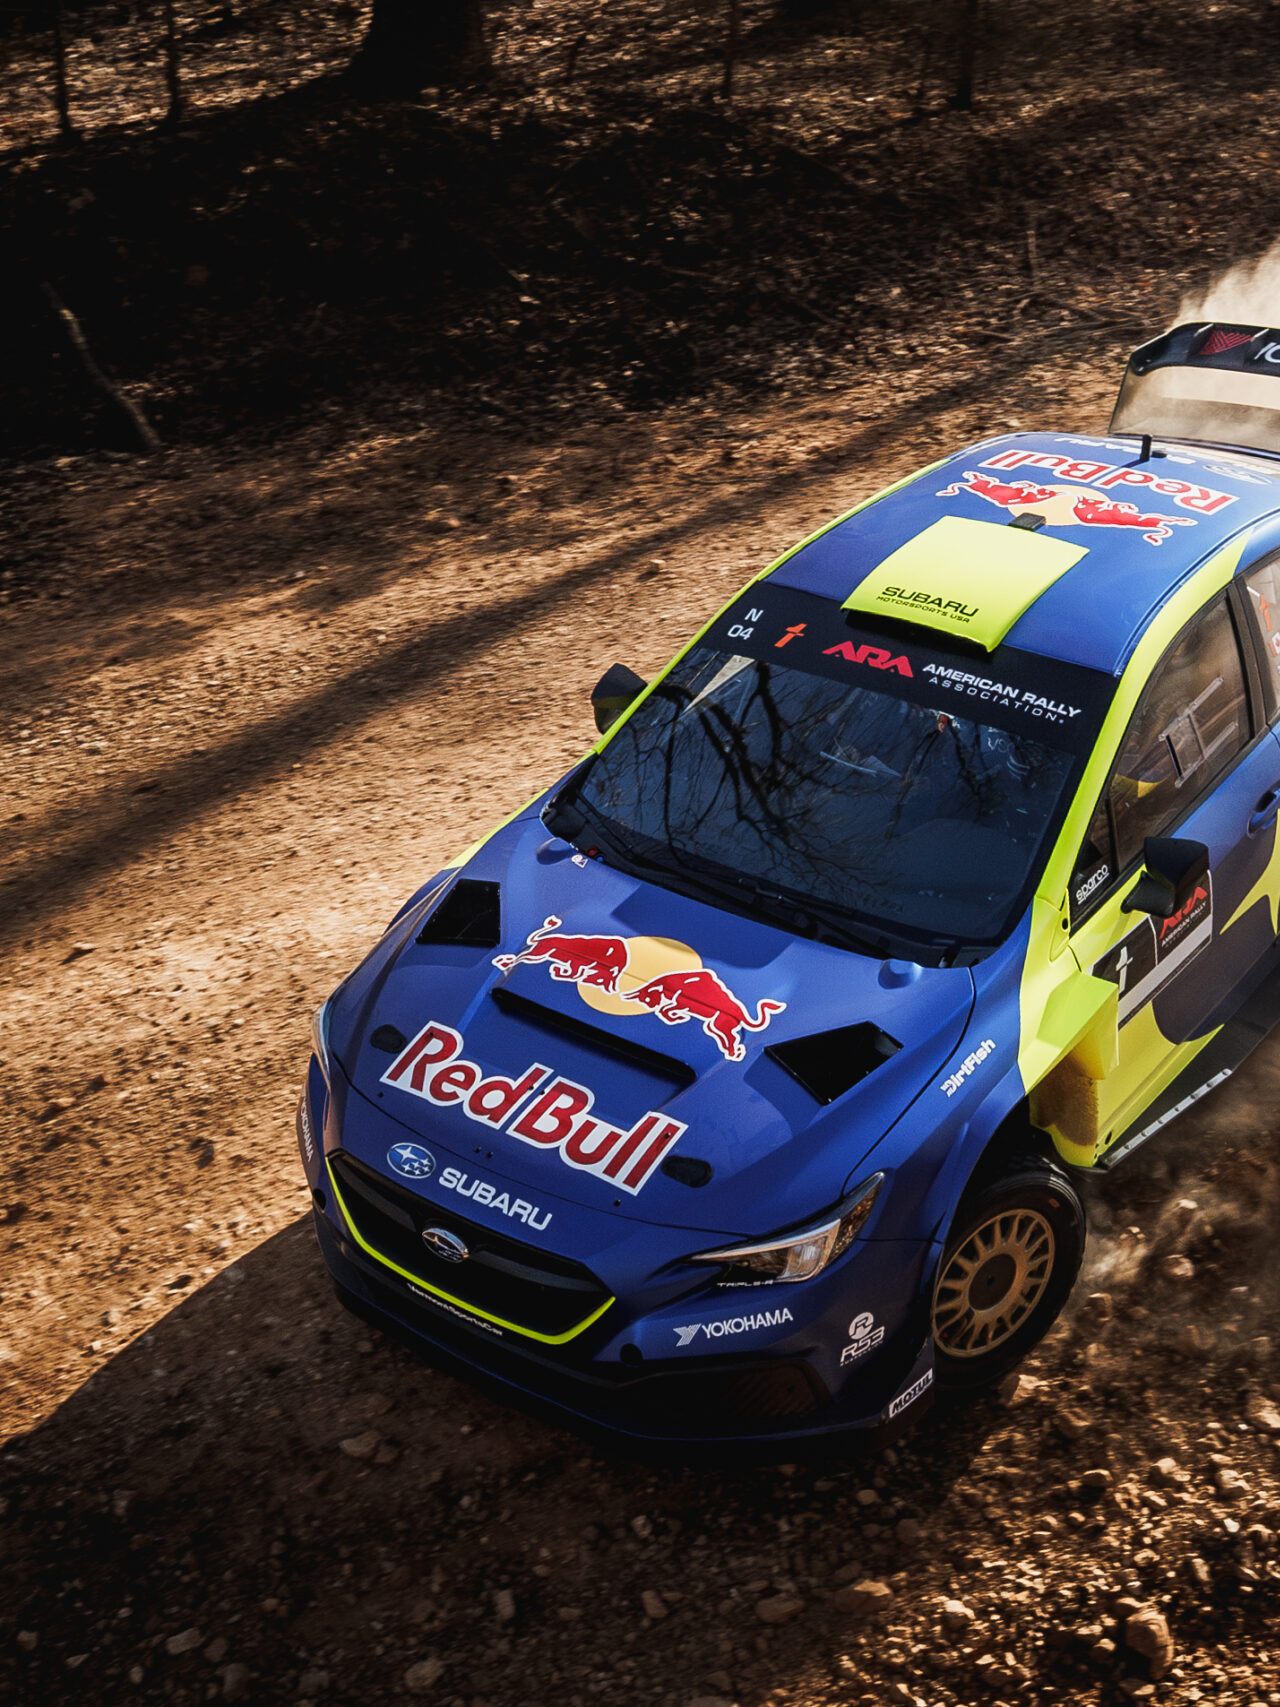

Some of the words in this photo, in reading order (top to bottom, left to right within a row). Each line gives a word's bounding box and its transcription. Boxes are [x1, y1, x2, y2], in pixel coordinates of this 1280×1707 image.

[978, 449, 1112, 484] Bull
[1093, 467, 1240, 515] Red
[744, 608, 764, 622] N
[876, 596, 949, 617] MOTORSPORTS
[950, 613, 971, 623] USA
[882, 586, 980, 617] SUBARU
[727, 624, 754, 640] 04
[821, 640, 914, 678] ARA
[922, 663, 1020, 698] AMERICAN
[1021, 691, 1082, 718] RALLY
[928, 676, 1058, 722] ASSOCIATION
[1075, 864, 1109, 902] sparco
[1161, 917, 1190, 947] AMERICAN
[1190, 901, 1207, 919] RALLY
[380, 1020, 554, 1130] Red
[505, 1075, 689, 1196] Bull
[438, 1167, 552, 1231] SUBARU
[702, 1307, 794, 1339] YOKOHAMA
[840, 1326, 885, 1362] R53
[891, 1371, 932, 1415] MOTUL
